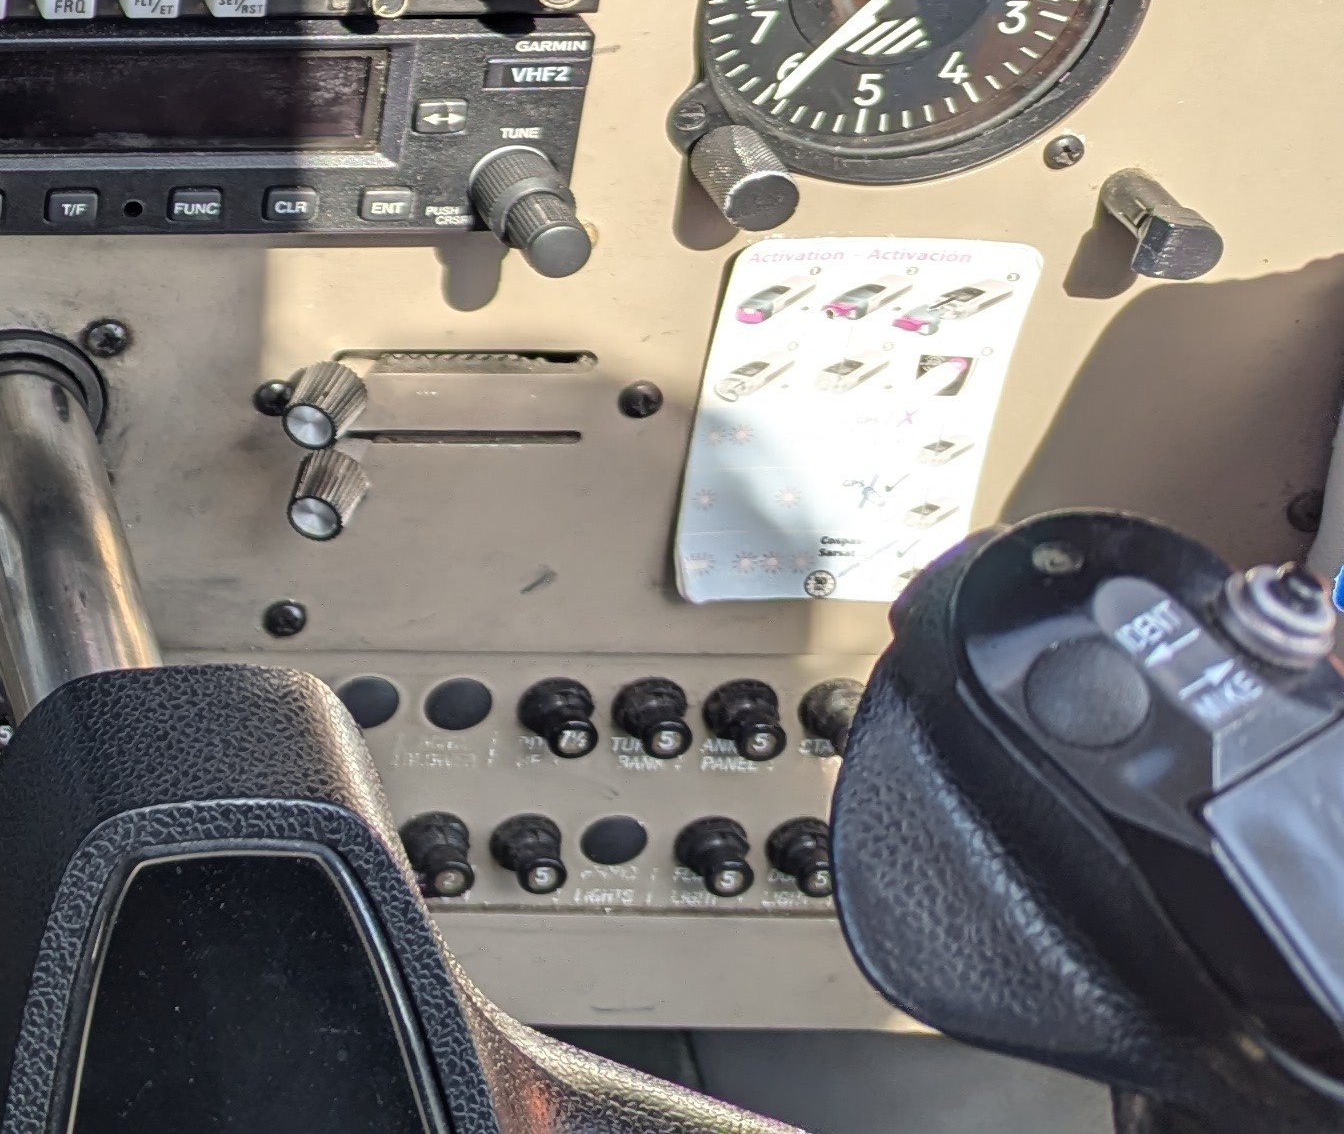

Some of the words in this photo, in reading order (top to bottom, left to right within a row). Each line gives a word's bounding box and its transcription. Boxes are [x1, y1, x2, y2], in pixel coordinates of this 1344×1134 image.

[54, 0, 86, 15] FRQ
[514, 39, 587, 54] GARMIN
[511, 66, 571, 82] VHF2
[748, 249, 844, 264] Activation
[867, 248, 972, 263] Activación
